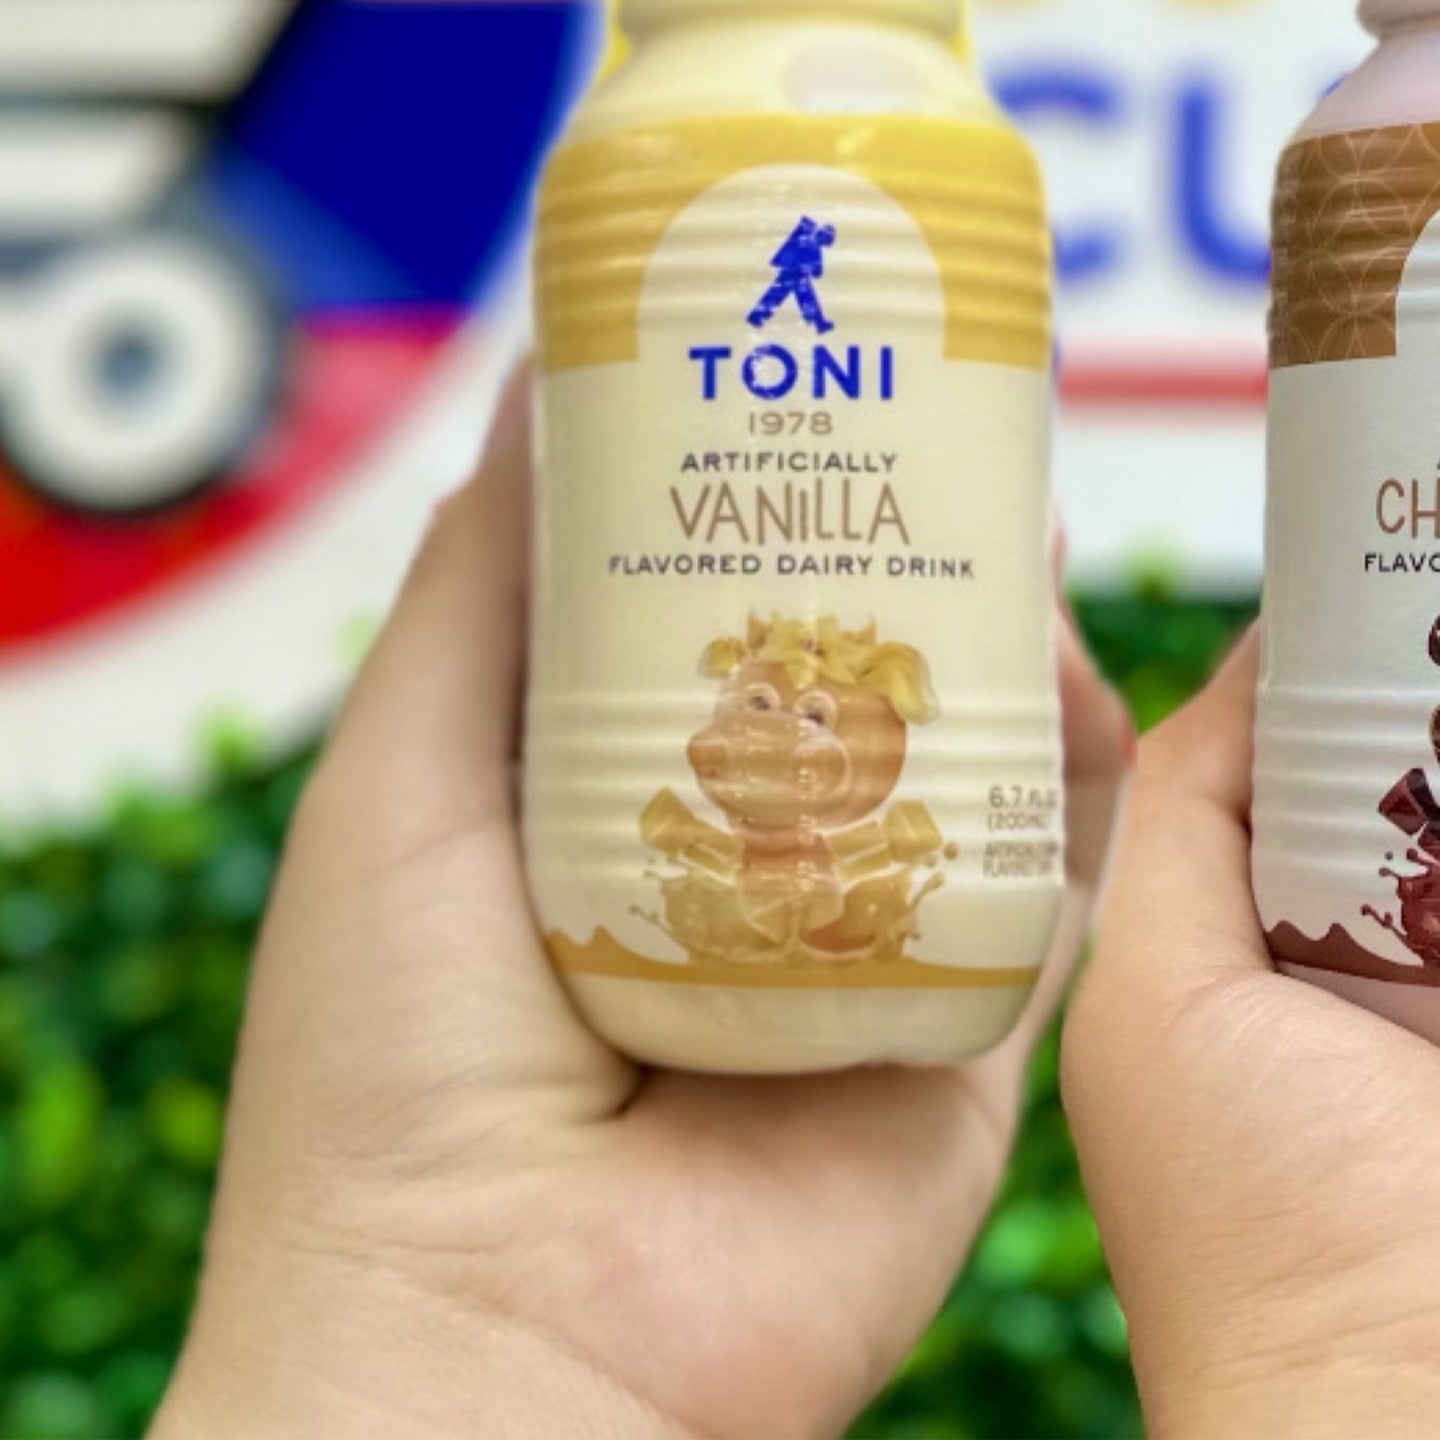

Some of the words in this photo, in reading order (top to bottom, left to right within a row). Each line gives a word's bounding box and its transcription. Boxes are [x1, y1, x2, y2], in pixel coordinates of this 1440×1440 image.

[688, 343, 893, 401] TONI
[748, 411, 833, 436] 1978
[681, 452, 897, 474] ARTIFICIALLY
[670, 477, 911, 546] VANILLA
[609, 554, 761, 577] FLAVORED
[777, 555, 873, 577] DAIRY
[887, 557, 975, 580] DRINK
